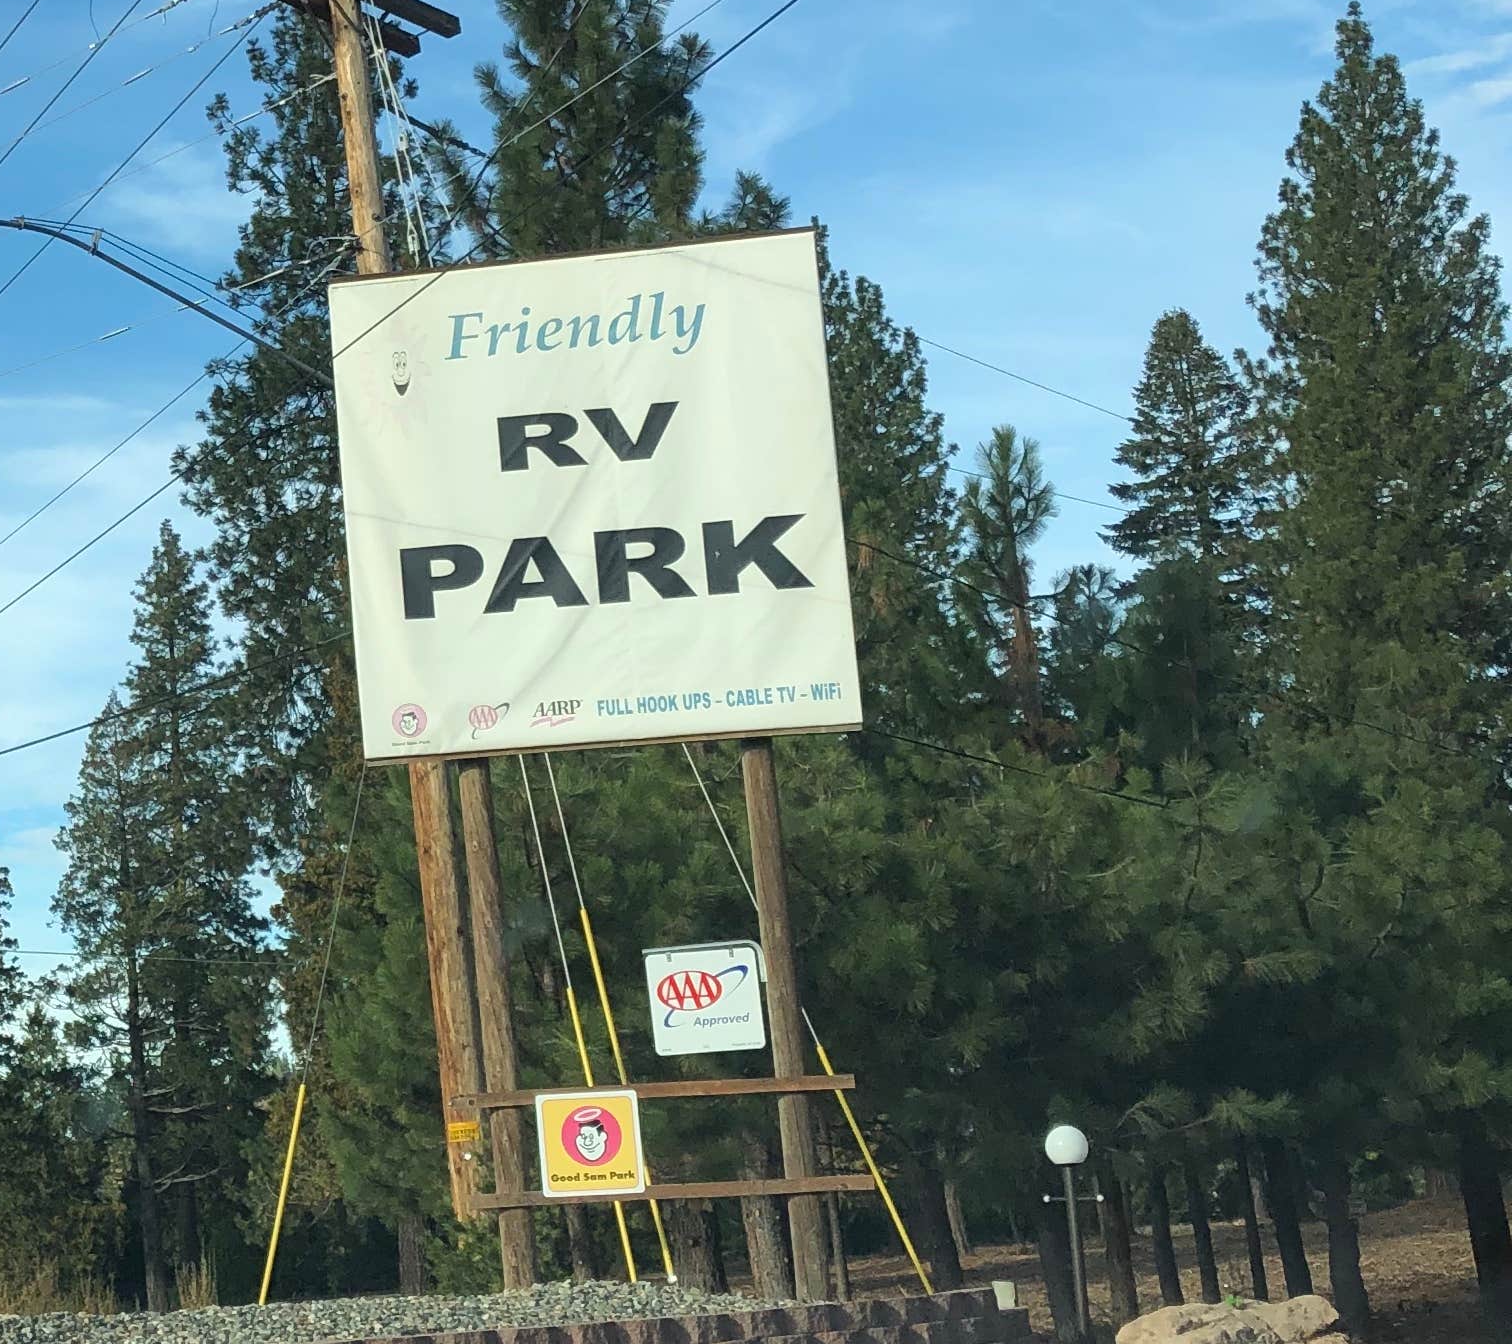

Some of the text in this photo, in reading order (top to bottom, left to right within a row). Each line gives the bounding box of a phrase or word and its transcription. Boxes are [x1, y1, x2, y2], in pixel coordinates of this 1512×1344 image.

[444, 290, 706, 361] Friendly
[496, 400, 680, 473] RV
[399, 513, 816, 620] PARK
[533, 699, 582, 718] AARP
[597, 697, 634, 716] FULL
[636, 694, 679, 714] HOOK
[682, 691, 712, 711] UPS
[726, 687, 774, 707] CABLE
[776, 685, 797, 703] TV
[810, 682, 842, 701] WiFi
[660, 971, 721, 1011] AAA
[693, 1012, 750, 1028] Approved
[551, 1170, 636, 1183] Good Sam Park
